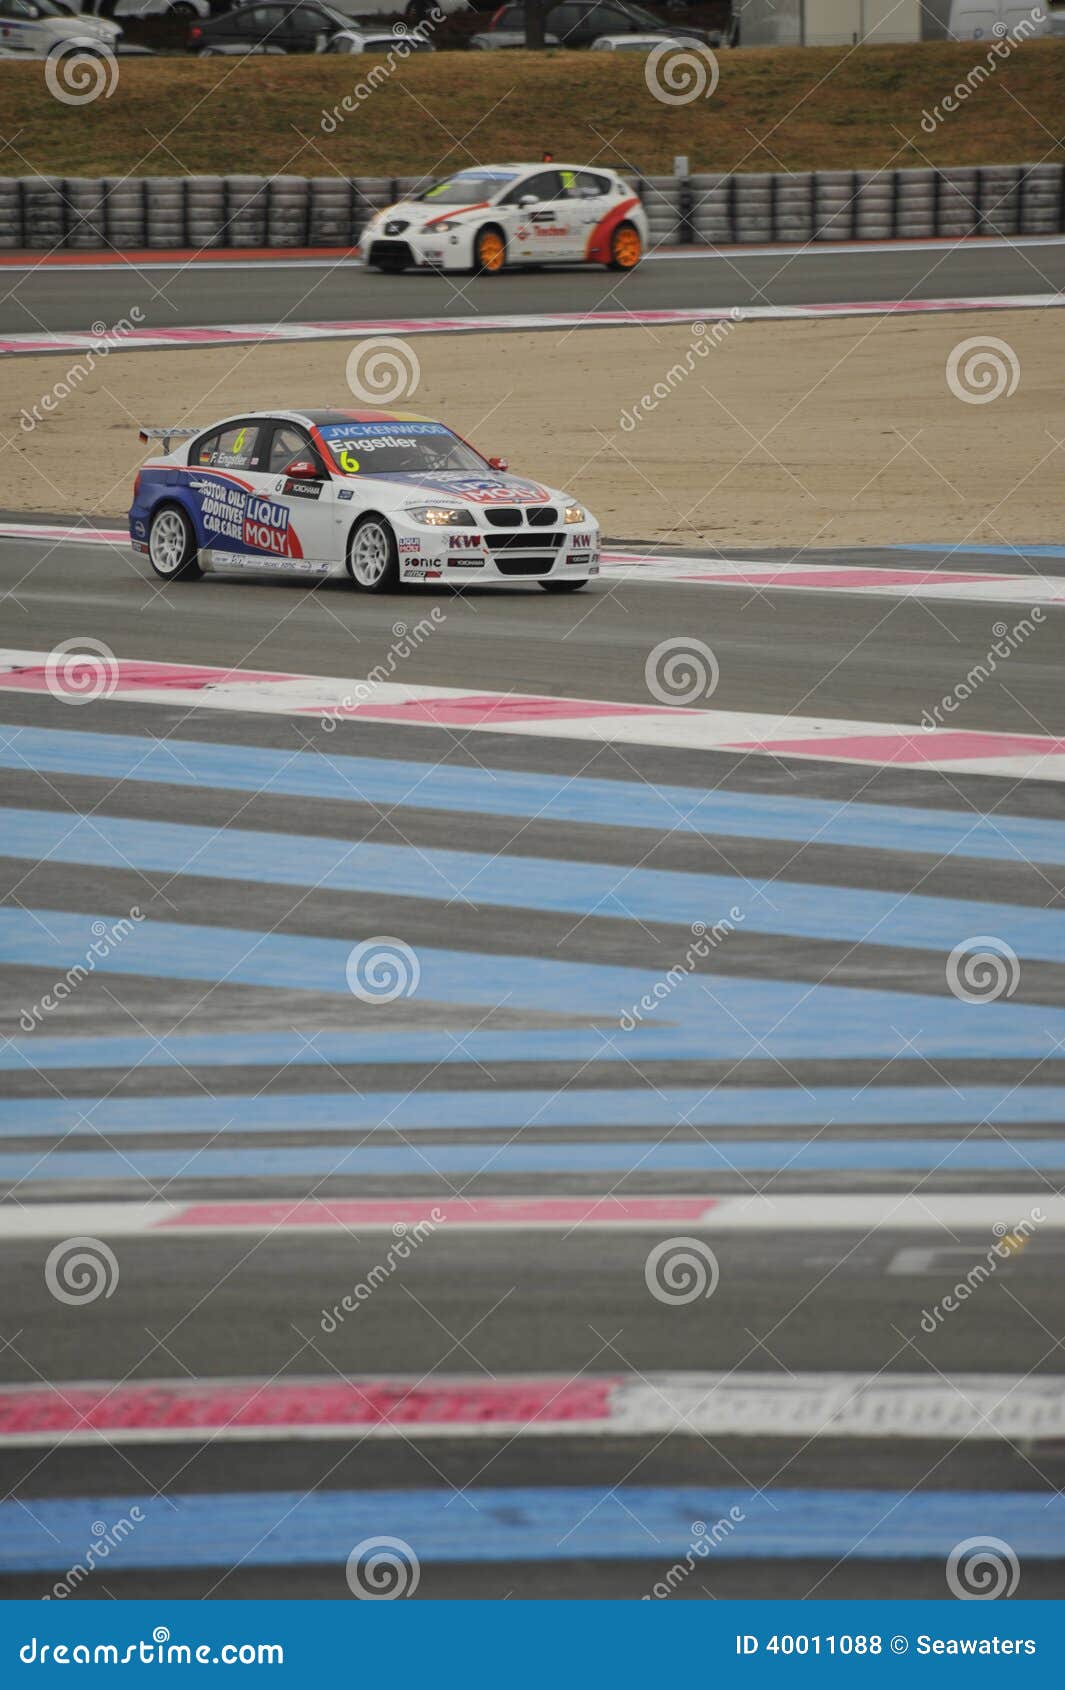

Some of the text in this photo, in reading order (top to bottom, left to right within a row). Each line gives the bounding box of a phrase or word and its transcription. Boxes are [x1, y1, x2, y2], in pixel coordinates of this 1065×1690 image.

[233, 427, 247, 454] 6
[327, 435, 417, 453] Engstler
[341, 450, 360, 473] 6
[275, 479, 283, 492] 6
[228, 490, 246, 508] OILS
[201, 497, 243, 524] ADDITIVES
[247, 498, 288, 530] LIQUI
[203, 514, 243, 541] CAR CARE
[245, 522, 288, 552] MOLY
[449, 535, 481, 548] KW
[573, 535, 591, 548] KW
[404, 557, 442, 568] sonic
